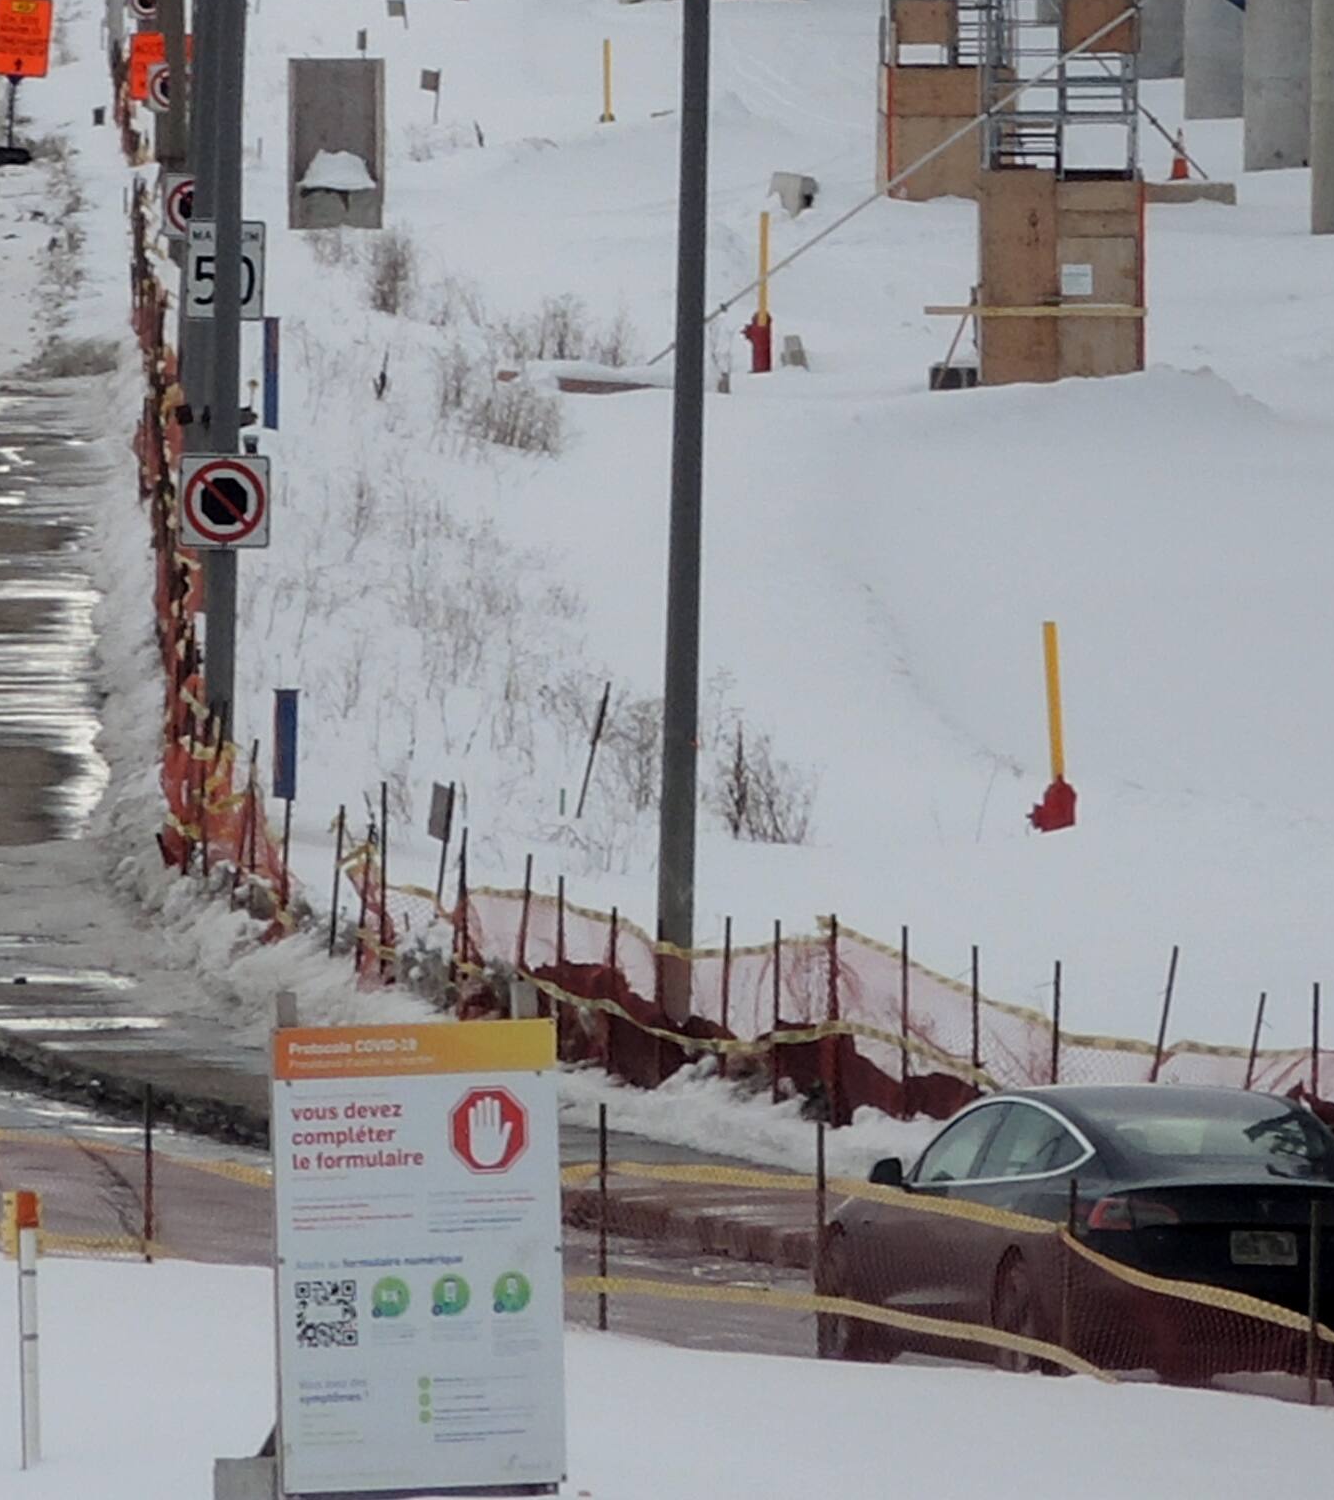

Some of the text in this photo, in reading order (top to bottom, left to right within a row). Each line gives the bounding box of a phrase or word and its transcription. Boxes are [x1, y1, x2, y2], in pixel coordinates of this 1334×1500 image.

[354, 1037, 418, 1053] COVID-19
[291, 1101, 403, 1122] vous devez
[291, 1124, 397, 1148] compléter
[292, 1148, 425, 1171] le formulaire
